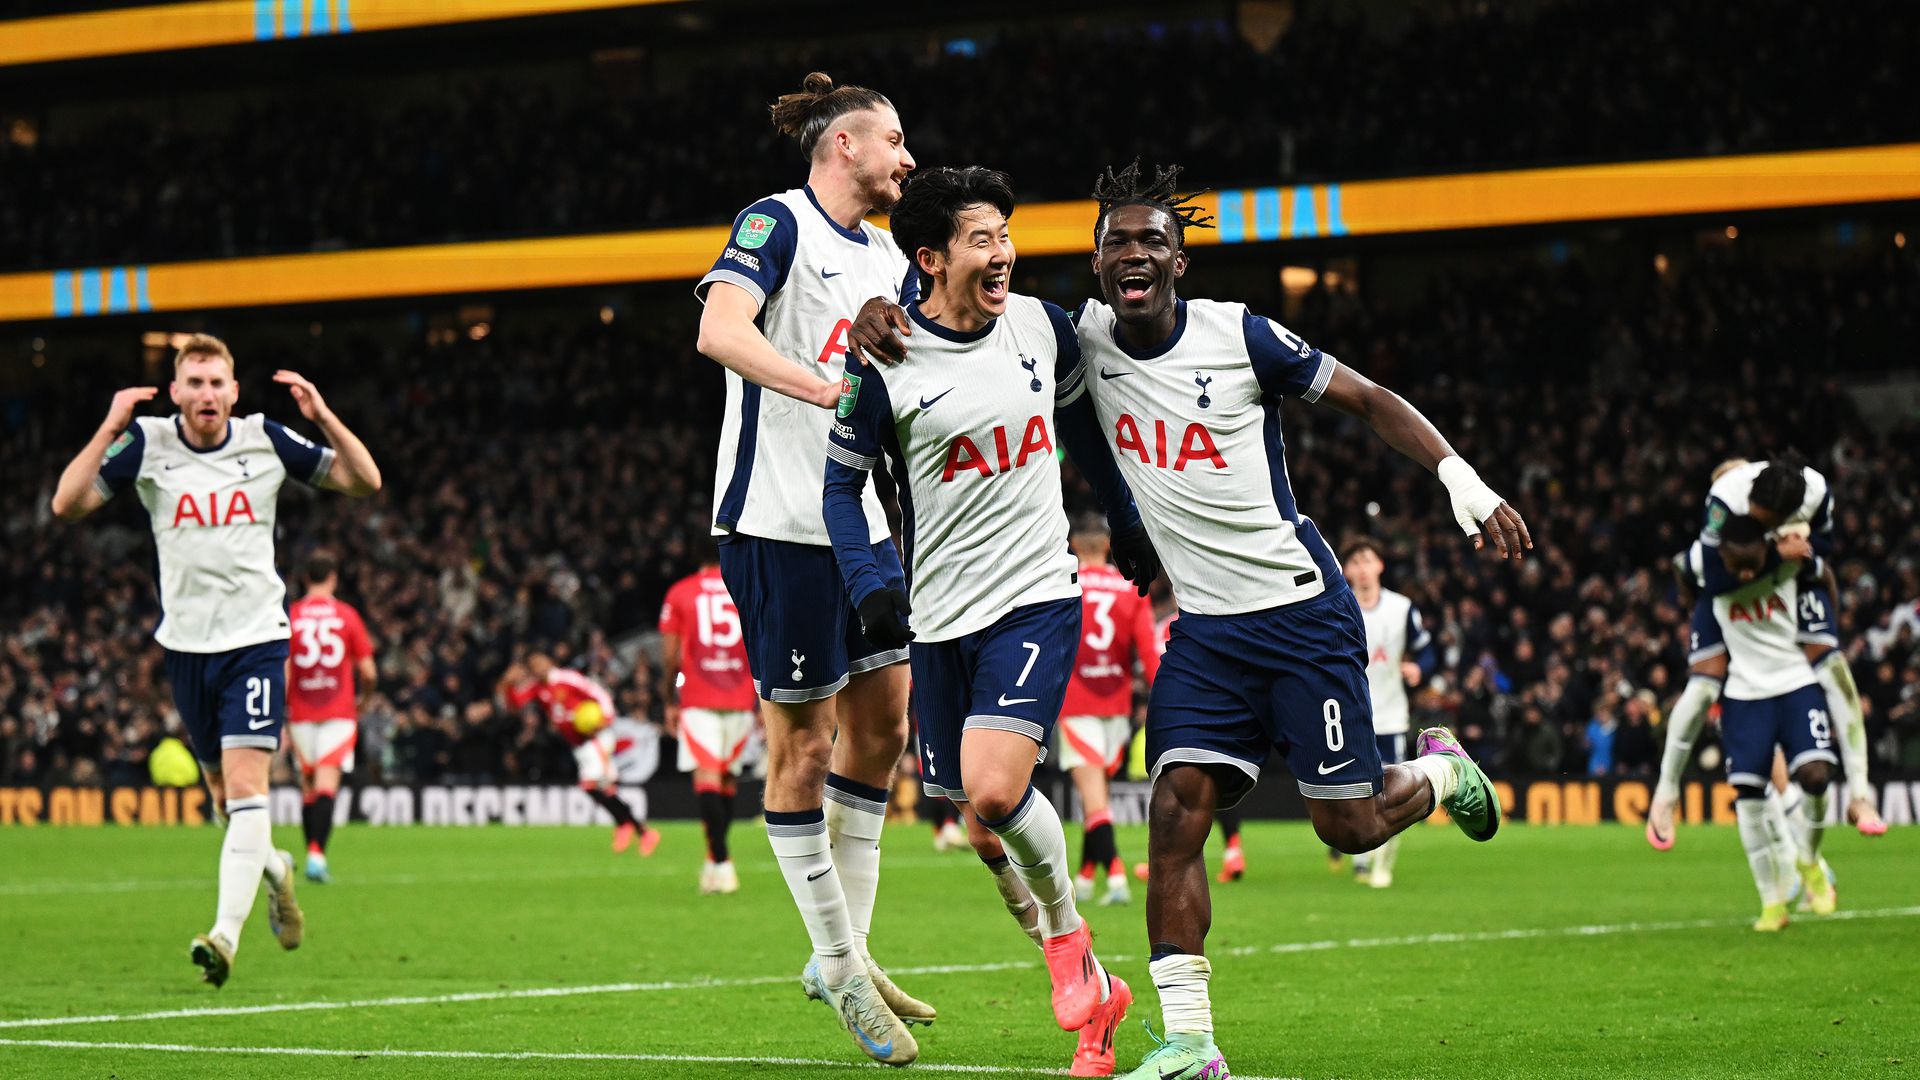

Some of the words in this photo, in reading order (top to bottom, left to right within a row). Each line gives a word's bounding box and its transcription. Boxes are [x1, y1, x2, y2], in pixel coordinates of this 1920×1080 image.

[1218, 183, 1349, 243] GOAL
[940, 415, 1053, 482] AIA
[1115, 413, 1228, 472] AIA
[173, 490, 256, 528] AIA
[695, 593, 742, 648] 15
[1085, 591, 1116, 651] 3
[1729, 592, 1788, 624] AIA
[1800, 590, 1826, 621] 24
[293, 617, 346, 669] 35
[1015, 641, 1041, 687] 7
[246, 676, 271, 716] 21
[1323, 698, 1344, 752] 8
[1526, 781, 1601, 825] ON
[1613, 781, 1738, 825] SLE
